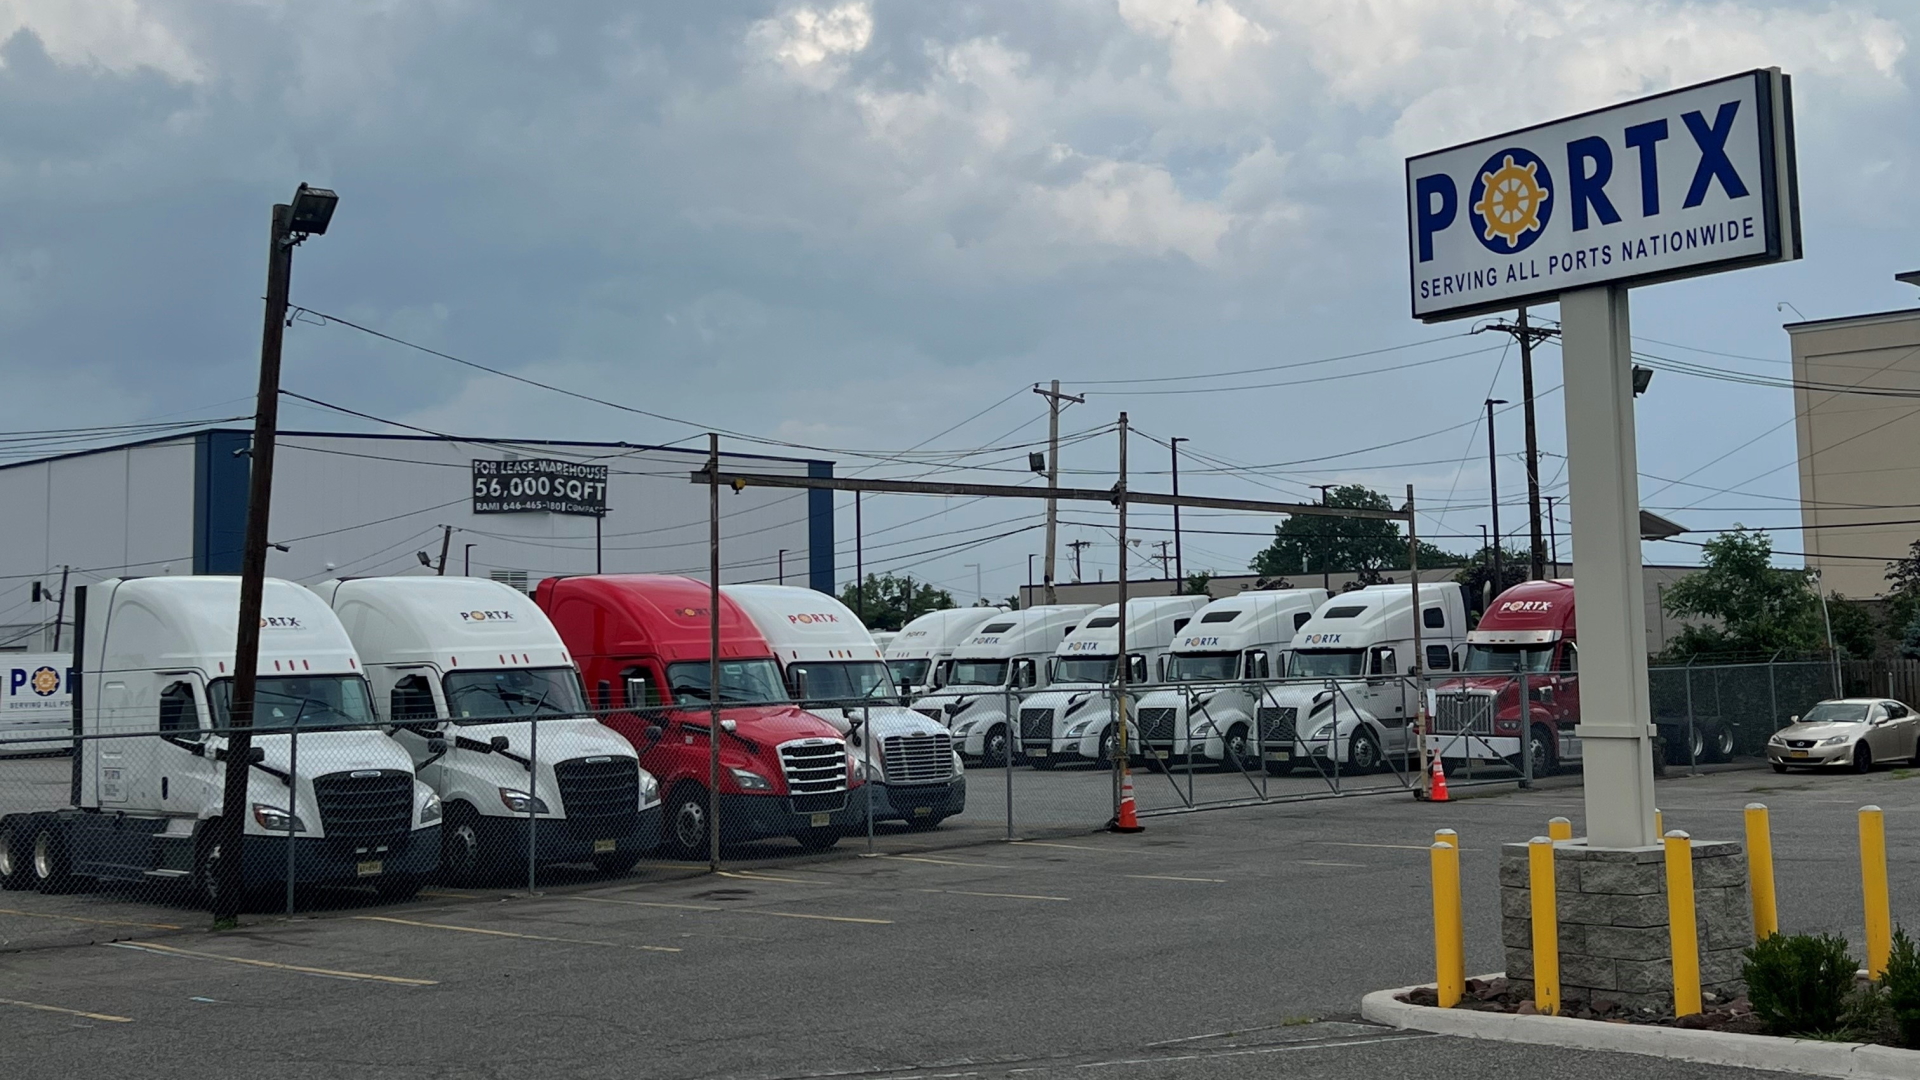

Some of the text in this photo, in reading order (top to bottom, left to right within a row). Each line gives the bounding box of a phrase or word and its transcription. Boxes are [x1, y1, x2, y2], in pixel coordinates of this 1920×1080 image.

[1416, 100, 1750, 263] PORTX
[1420, 216, 1755, 299] SERVING ALL PORTS NATIONWIDE
[474, 461, 497, 475] FOR
[475, 477, 605, 500] 56,000 SQFT
[476, 502, 499, 511] RAMI
[1500, 600, 1551, 611] PORTX
[460, 610, 514, 621] PORTX
[674, 607, 711, 618] PORT
[260, 616, 301, 628] RTX
[787, 613, 838, 624] PORTX
[972, 636, 1000, 645] PORTX
[1185, 636, 1219, 648] PORTX
[1305, 633, 1342, 645] PORTX
[1067, 641, 1098, 652] PORTX
[10, 665, 74, 697] PO
[44, 700, 57, 708] ALL
